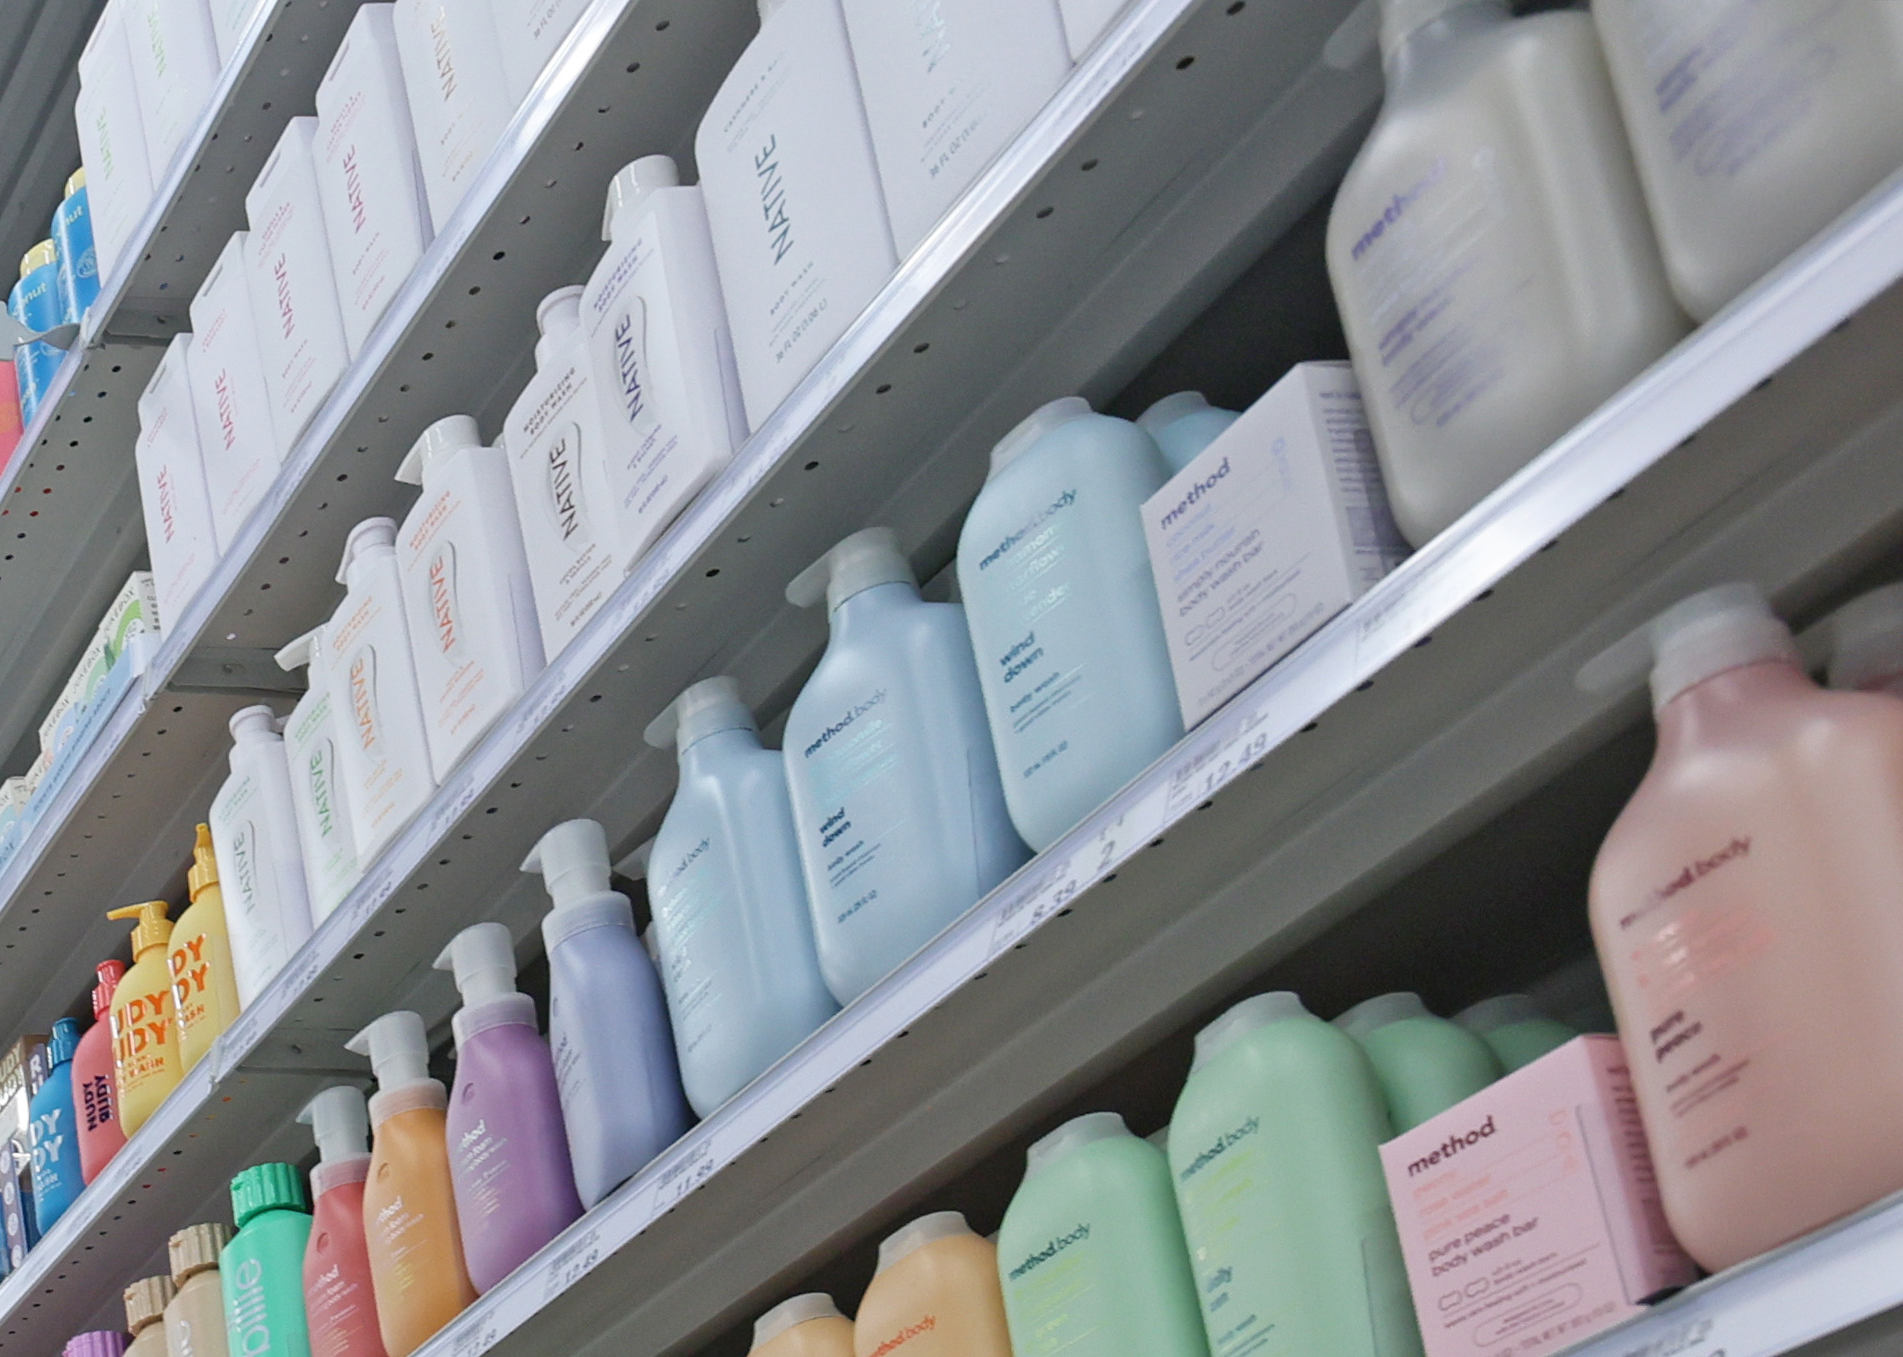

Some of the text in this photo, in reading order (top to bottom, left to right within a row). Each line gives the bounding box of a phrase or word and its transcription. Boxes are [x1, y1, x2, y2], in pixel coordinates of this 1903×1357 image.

[430, 7, 458, 101] NATIVE
[343, 144, 367, 234] NATIVE
[754, 132, 794, 266] NATIVE
[274, 253, 296, 340] NATIVE
[614, 313, 644, 421] NATIVE
[215, 368, 235, 451] NATIVE
[157, 464, 173, 544] NATIVE
[549, 438, 578, 540] NATIVE
[1161, 457, 1231, 530] method
[430, 555, 456, 653] NATIVE
[1000, 631, 1036, 667] wind
[1004, 647, 1044, 683] down
[350, 658, 375, 748] NATIVE
[805, 688, 888, 758] method.body
[310, 750, 333, 838] NATIVE
[820, 808, 845, 834] wind
[822, 821, 851, 848] down
[1096, 841, 1116, 869] 2
[1407, 1115, 1496, 1177] method
[1010, 1223, 1091, 1281] method.body
[1429, 1214, 1510, 1262] pure peace
[1432, 1217, 1538, 1277] body wash bar
